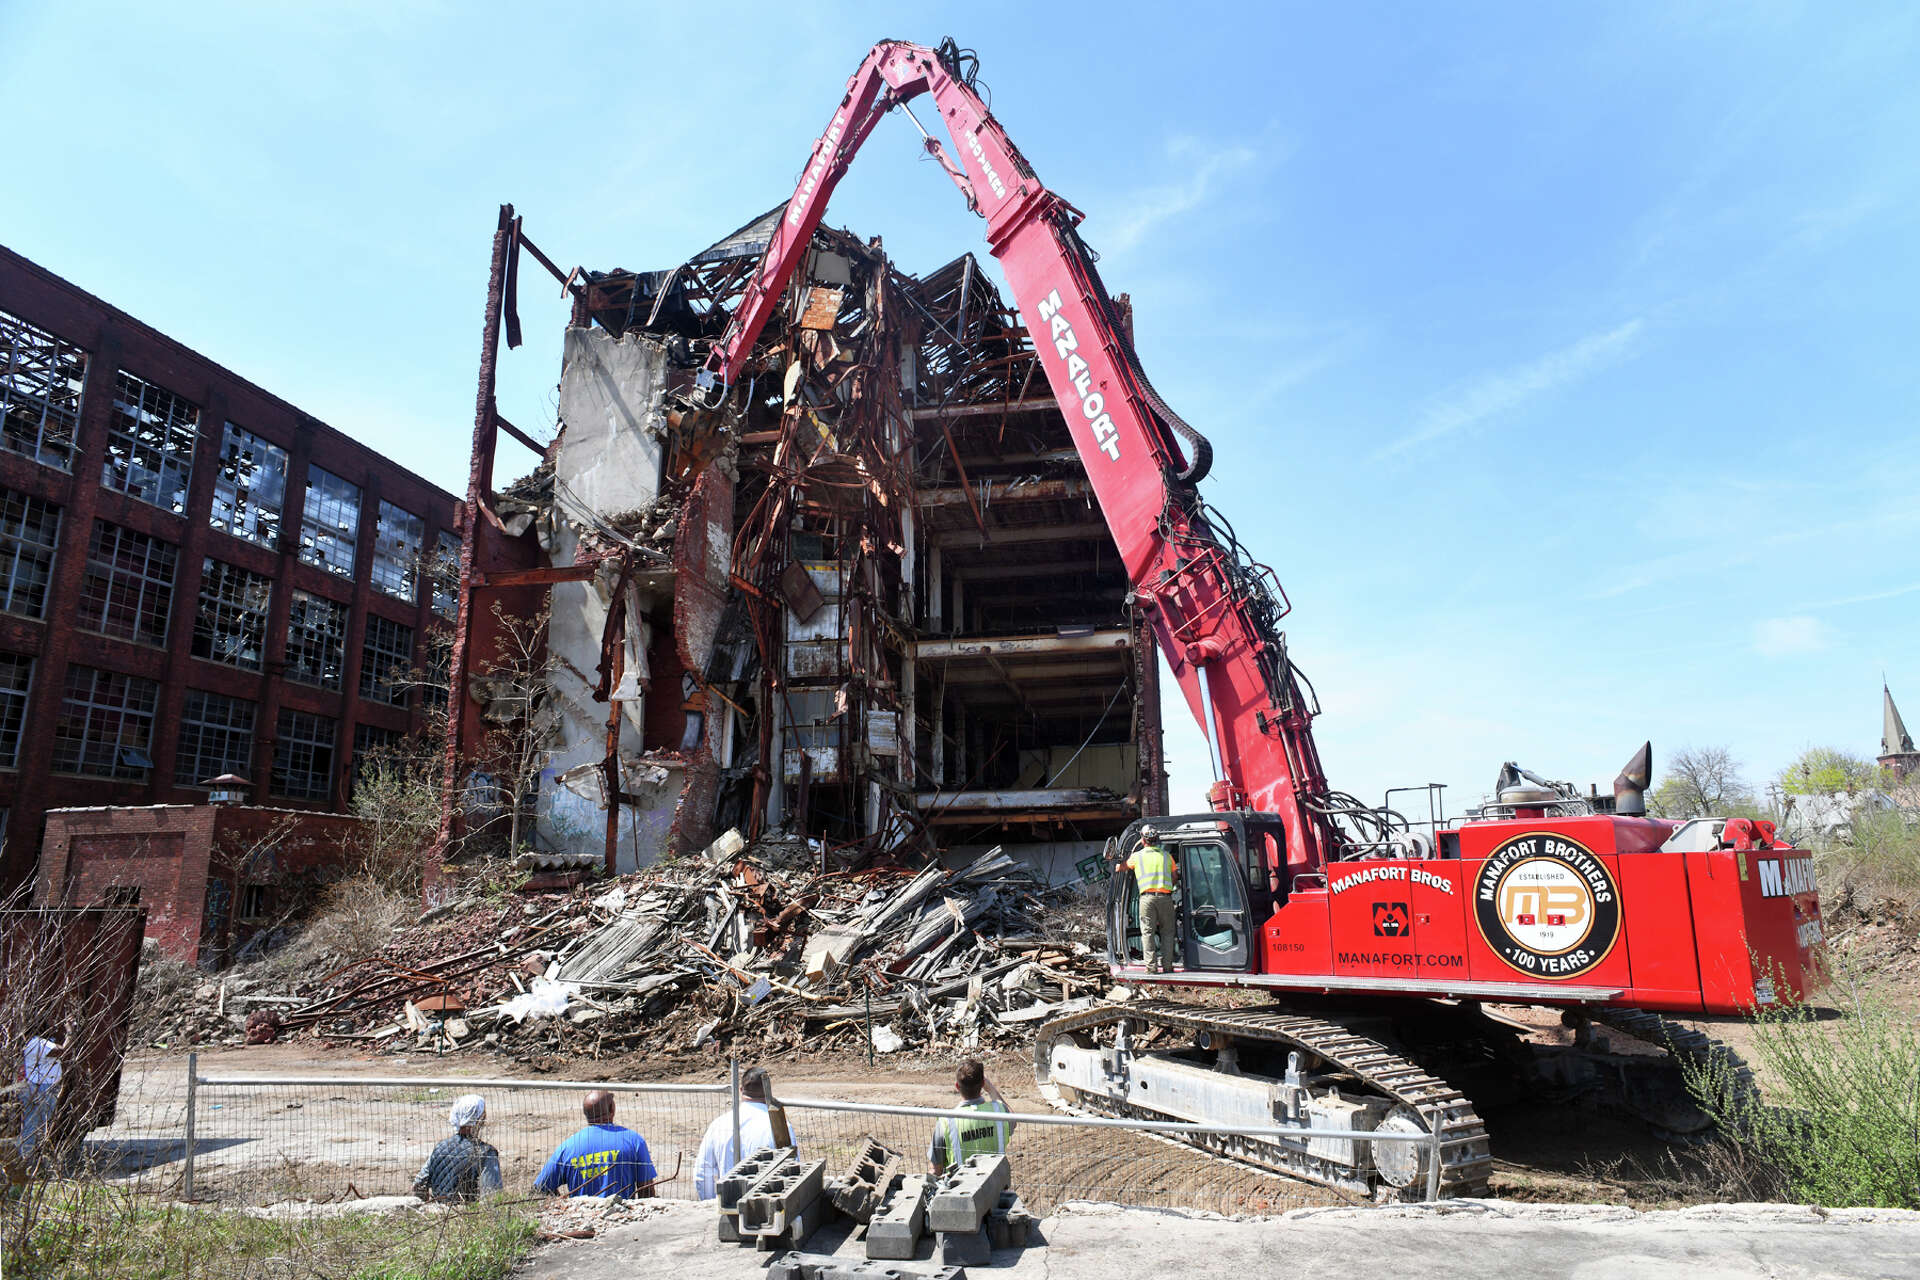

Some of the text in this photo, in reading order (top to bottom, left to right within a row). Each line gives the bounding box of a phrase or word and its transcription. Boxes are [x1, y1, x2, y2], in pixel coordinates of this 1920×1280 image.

[789, 111, 845, 226] MANAFORT
[1037, 287, 1121, 463] MANAFORT
[1331, 866, 1454, 896] MANAFORT BROS.
[1480, 839, 1612, 903] MANAFORT BROTHERS
[1519, 873, 1565, 881] ESTABLISHED
[1272, 943, 1305, 952] 108150
[1338, 952, 1464, 967] MANAFORT.COM
[1513, 948, 1590, 973] 100 YEARS
[961, 1126, 995, 1142] MANAFORT
[570, 1149, 620, 1169] SAFETY
[581, 1165, 608, 1180] TEAM
